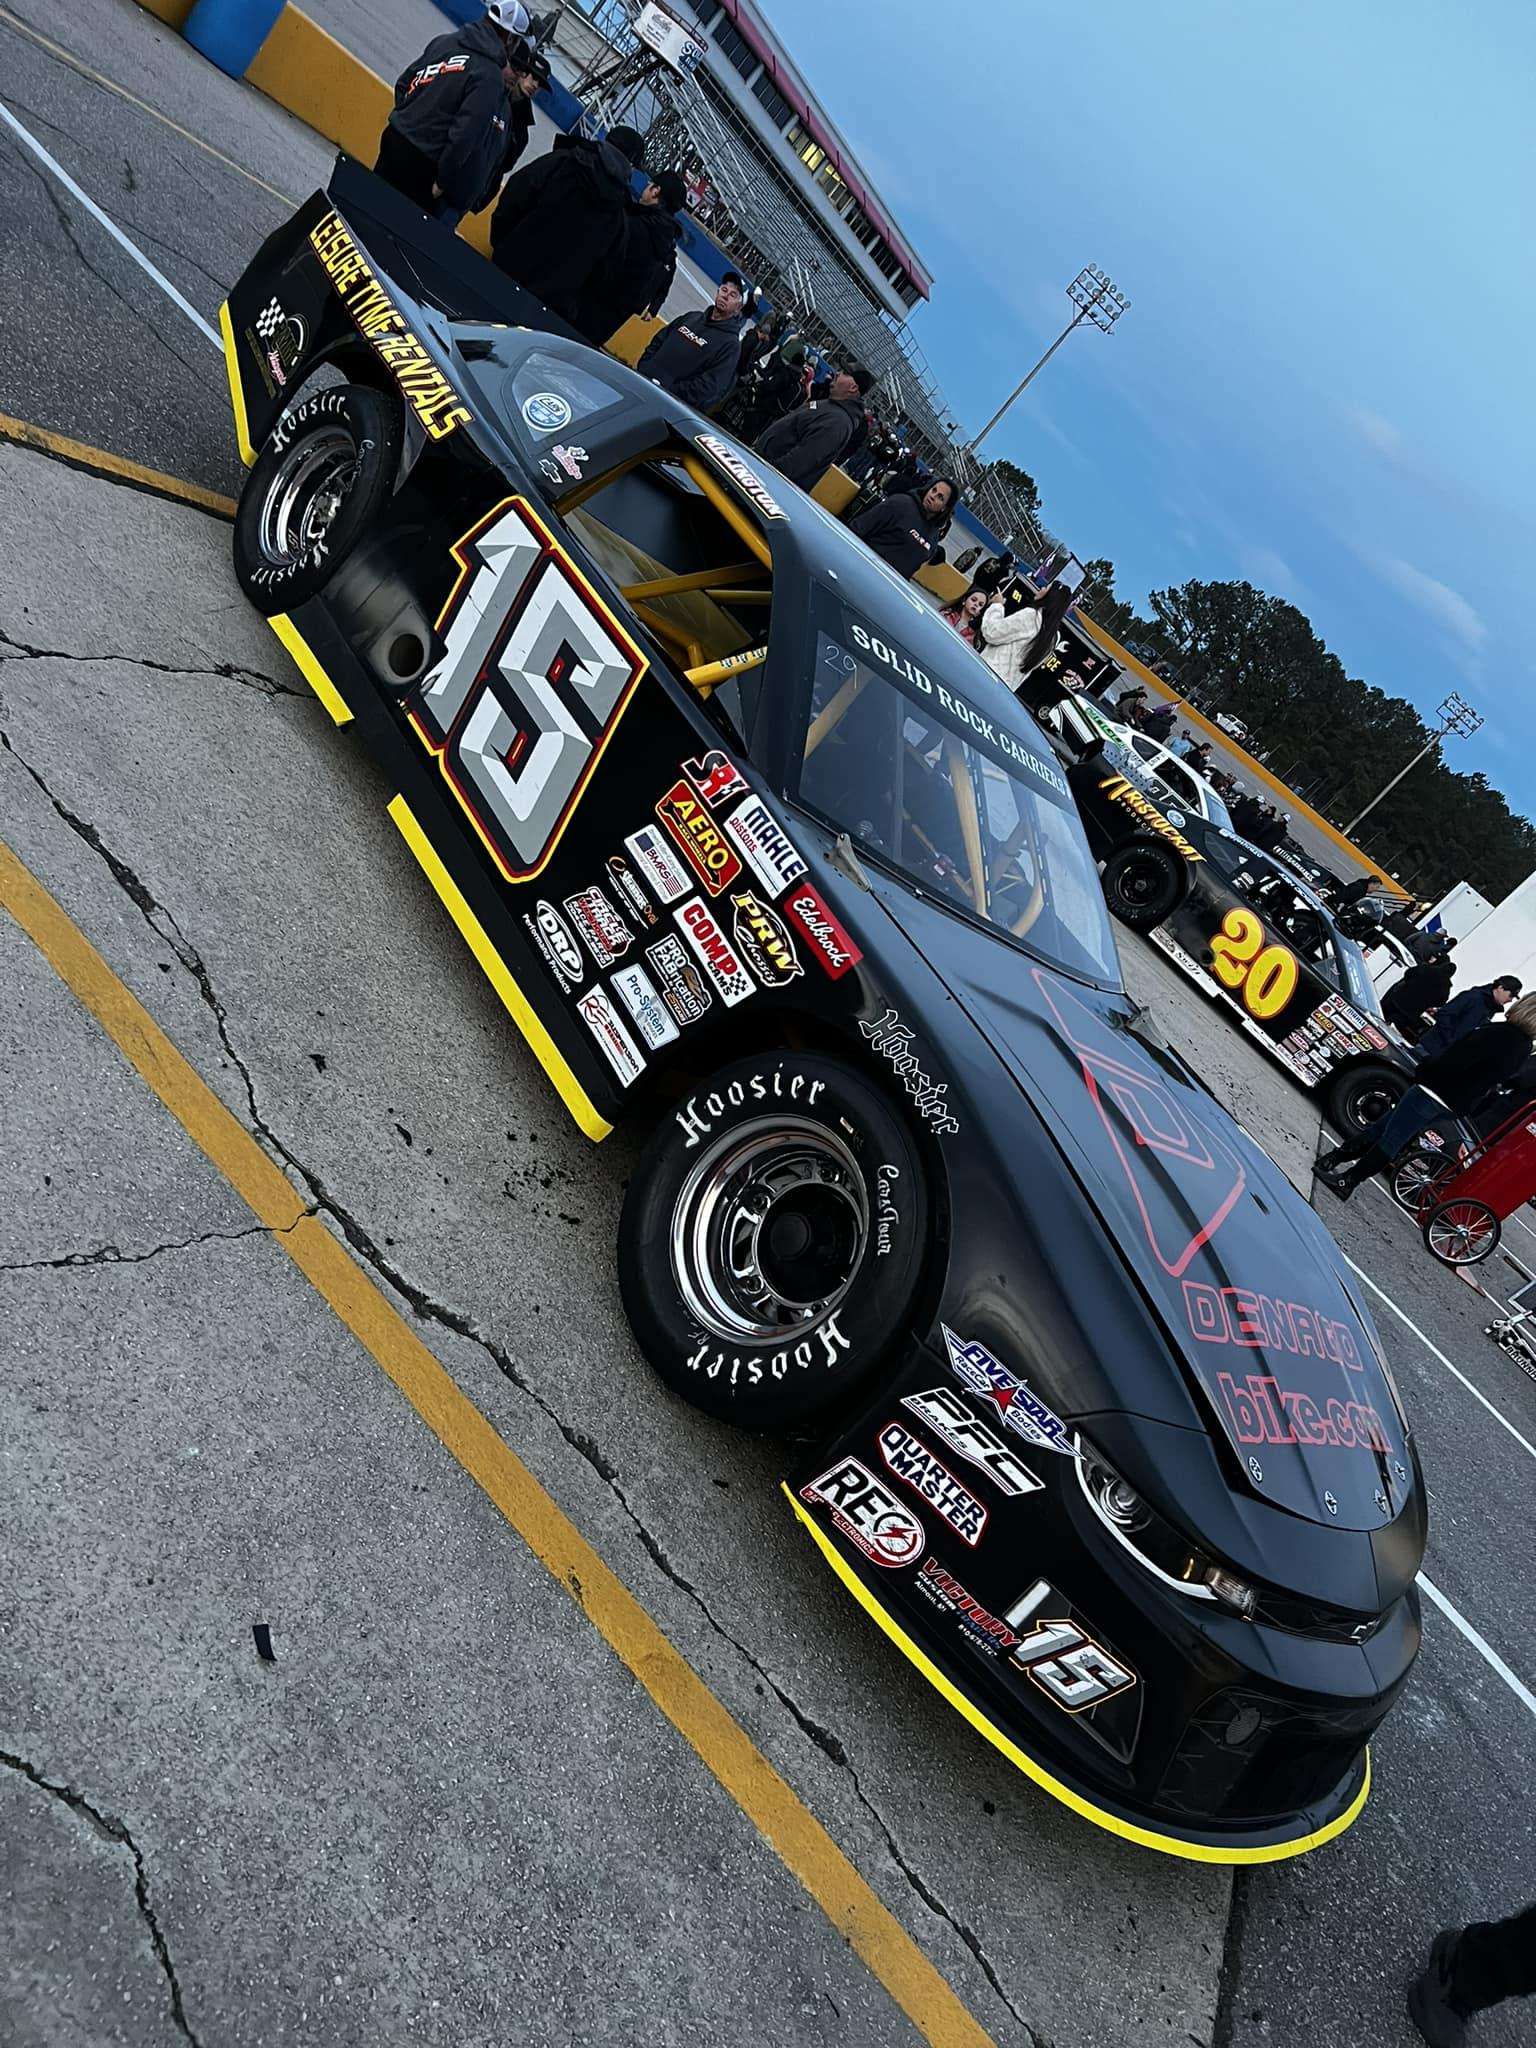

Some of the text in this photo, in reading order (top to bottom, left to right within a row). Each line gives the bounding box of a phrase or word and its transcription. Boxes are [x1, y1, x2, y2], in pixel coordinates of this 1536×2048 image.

[309, 211, 474, 440] LEISURE TYME RENTALS
[273, 390, 351, 453] Hoosier
[700, 434, 786, 518] MILLINGTON
[410, 502, 641, 870] 15
[824, 645, 858, 689] 29
[851, 624, 933, 695] SOLID
[937, 683, 998, 746] ROCK
[674, 800, 729, 869] AERO
[729, 817, 758, 854] pistons
[744, 806, 804, 882] MAHLE
[1099, 775, 1207, 862] ARISTOCRAT
[646, 848, 671, 880] BMRS
[522, 913, 572, 995] Performance Products
[539, 912, 580, 969] DRP
[664, 938, 687, 968] PRO
[683, 904, 738, 975] COMP
[735, 896, 799, 971] PRW
[736, 925, 776, 982] Chassis
[793, 896, 850, 968] Edelbrock
[1209, 906, 1299, 1019] 20
[627, 974, 665, 1036] Pro-System
[707, 962, 733, 996] CAMS
[676, 1062, 825, 1147] Hoosier
[858, 1009, 959, 1135] Hoosier
[687, 1308, 850, 1384] Hoosier
[911, 1399, 969, 1450] BRAKES
[955, 1354, 1044, 1440] RaceCar Bodies
[963, 1344, 1065, 1438] FIVE STAR
[1216, 1371, 1394, 1454] bike.com
[882, 1425, 986, 1525] QUARTER
[916, 1390, 1043, 1492] PFC
[889, 1453, 978, 1541] MASTER
[922, 1556, 1021, 1647] VICTORY
[1012, 1621, 1134, 1710] 15
